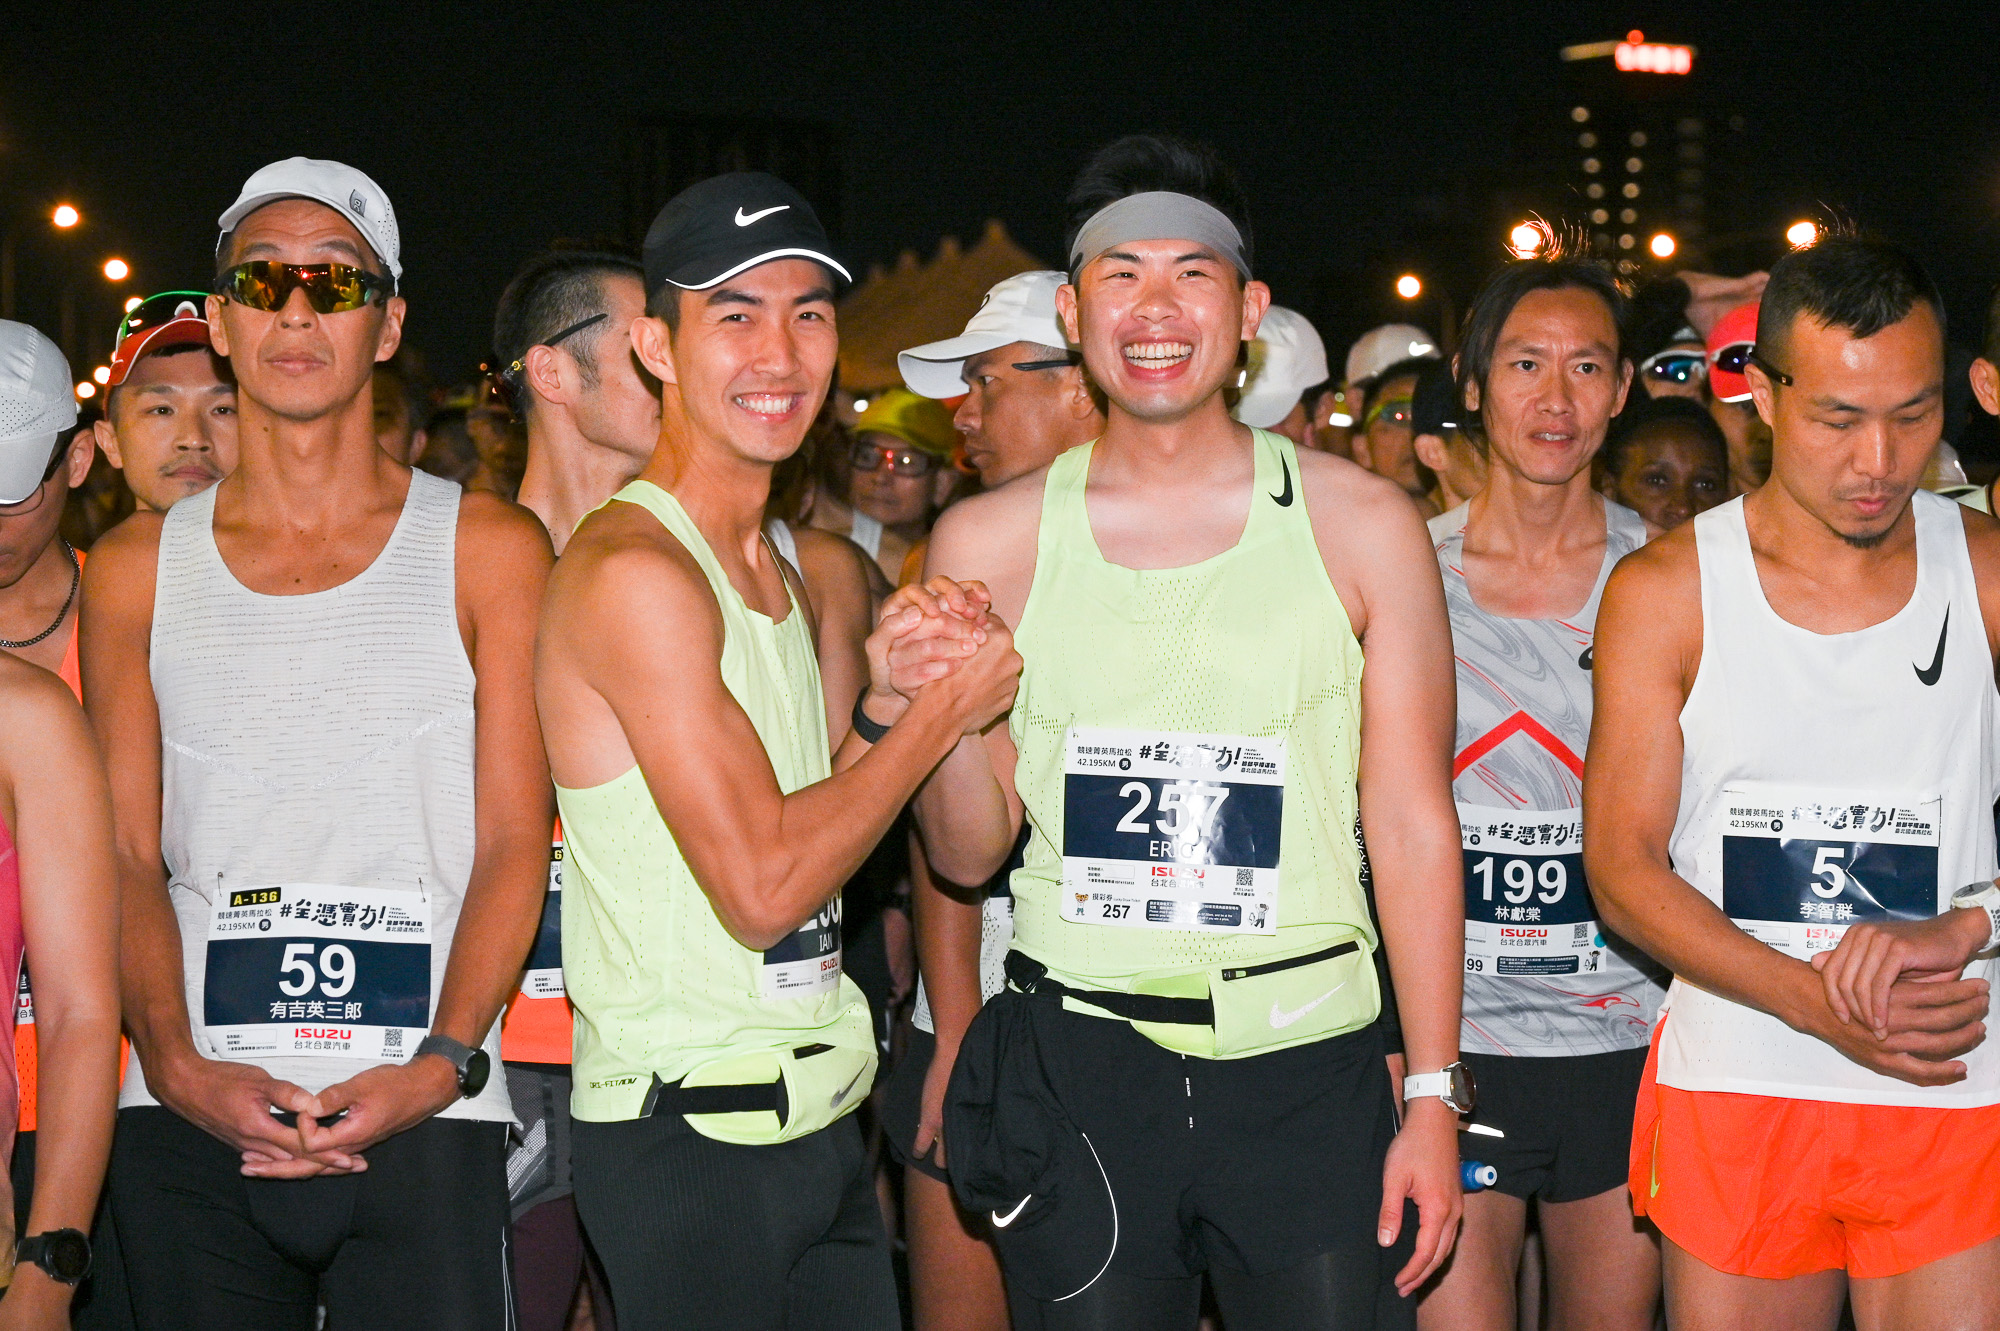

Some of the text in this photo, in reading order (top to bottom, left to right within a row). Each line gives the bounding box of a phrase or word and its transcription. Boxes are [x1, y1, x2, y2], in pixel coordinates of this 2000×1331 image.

[1077, 758, 1116, 767] 42.195KM
[1115, 781, 1230, 837] 257
[1730, 820, 1768, 829] 42.195KM
[1473, 856, 1567, 904] 199
[1810, 846, 1846, 899] 5
[233, 891, 278, 906] A-136
[1102, 904, 1131, 919] 257
[1799, 901, 1853, 921] 李智群
[216, 922, 256, 931] 42.195KM
[1500, 928, 1548, 937] ISUZU
[819, 932, 833, 952] IAN
[278, 943, 356, 998] 59
[269, 1000, 363, 1021] 有吉英三郎
[294, 1028, 352, 1040] ISUZU
